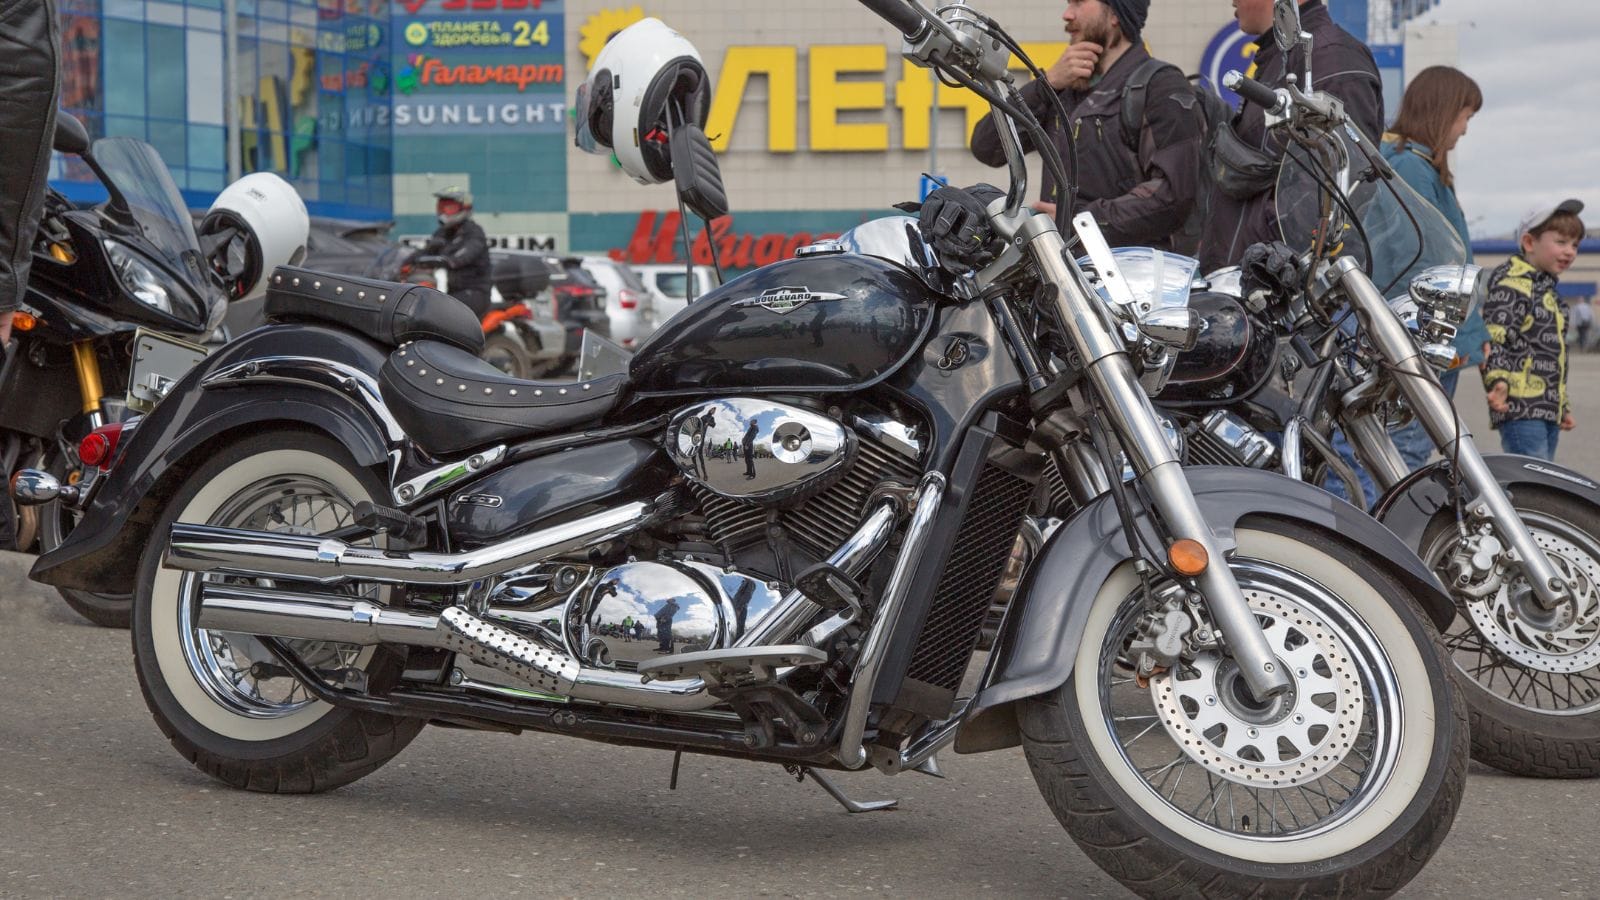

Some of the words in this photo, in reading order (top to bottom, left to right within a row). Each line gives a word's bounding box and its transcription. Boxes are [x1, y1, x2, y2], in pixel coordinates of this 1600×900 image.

[431, 21, 501, 33] ПЛАНЕТА
[513, 20, 549, 46] 24
[421, 59, 563, 91] Галамарт
[704, 42, 1153, 152] ЛЕН
[395, 103, 565, 125] SUNLIGHT
[755, 294, 811, 303] BOULEVARD
[1519, 357, 1557, 373] СЛНЦЕ
